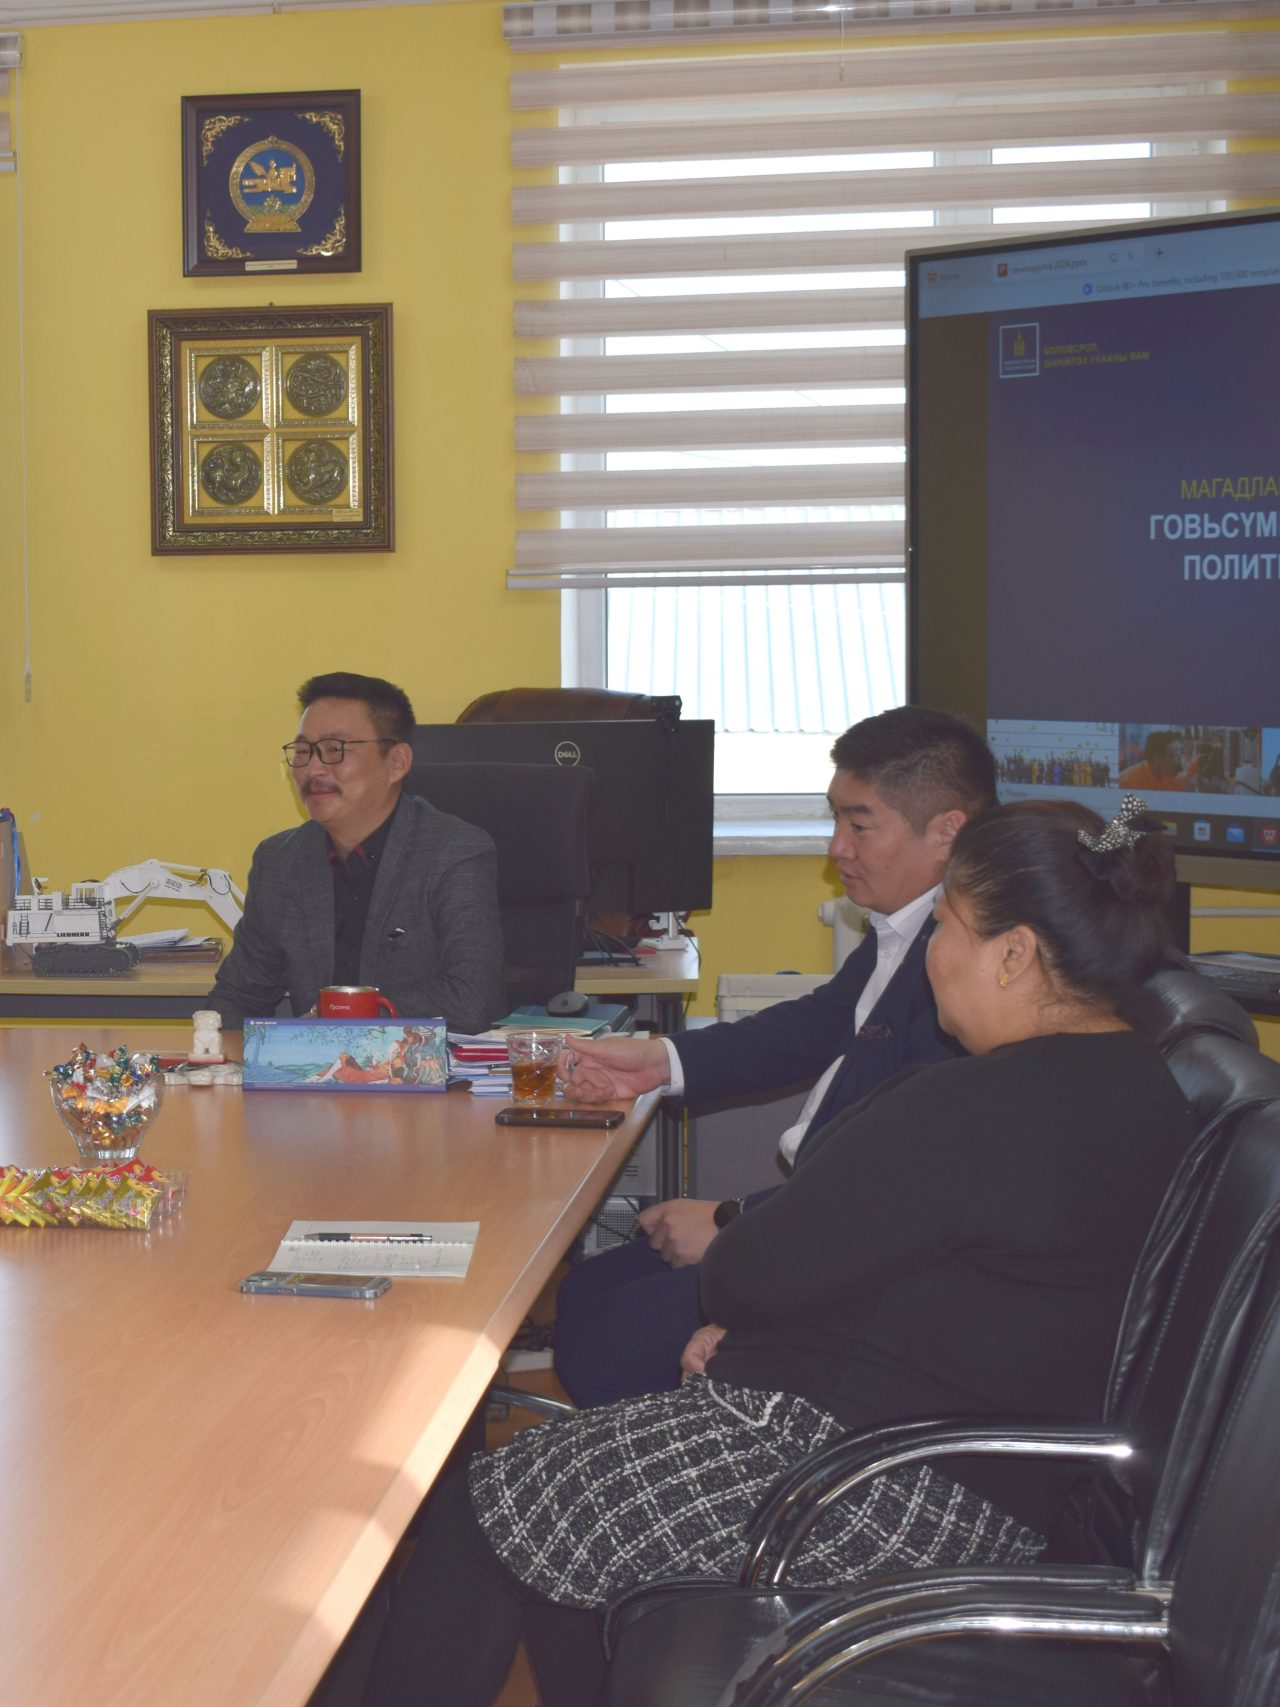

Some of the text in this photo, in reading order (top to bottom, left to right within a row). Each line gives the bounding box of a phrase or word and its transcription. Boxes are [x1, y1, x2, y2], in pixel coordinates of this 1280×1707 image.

[1181, 476, 1280, 501] МАГАДЛА
[1149, 511, 1280, 540] ГОВЬСҮМ
[1183, 553, 1280, 580] ПОЛИТ
